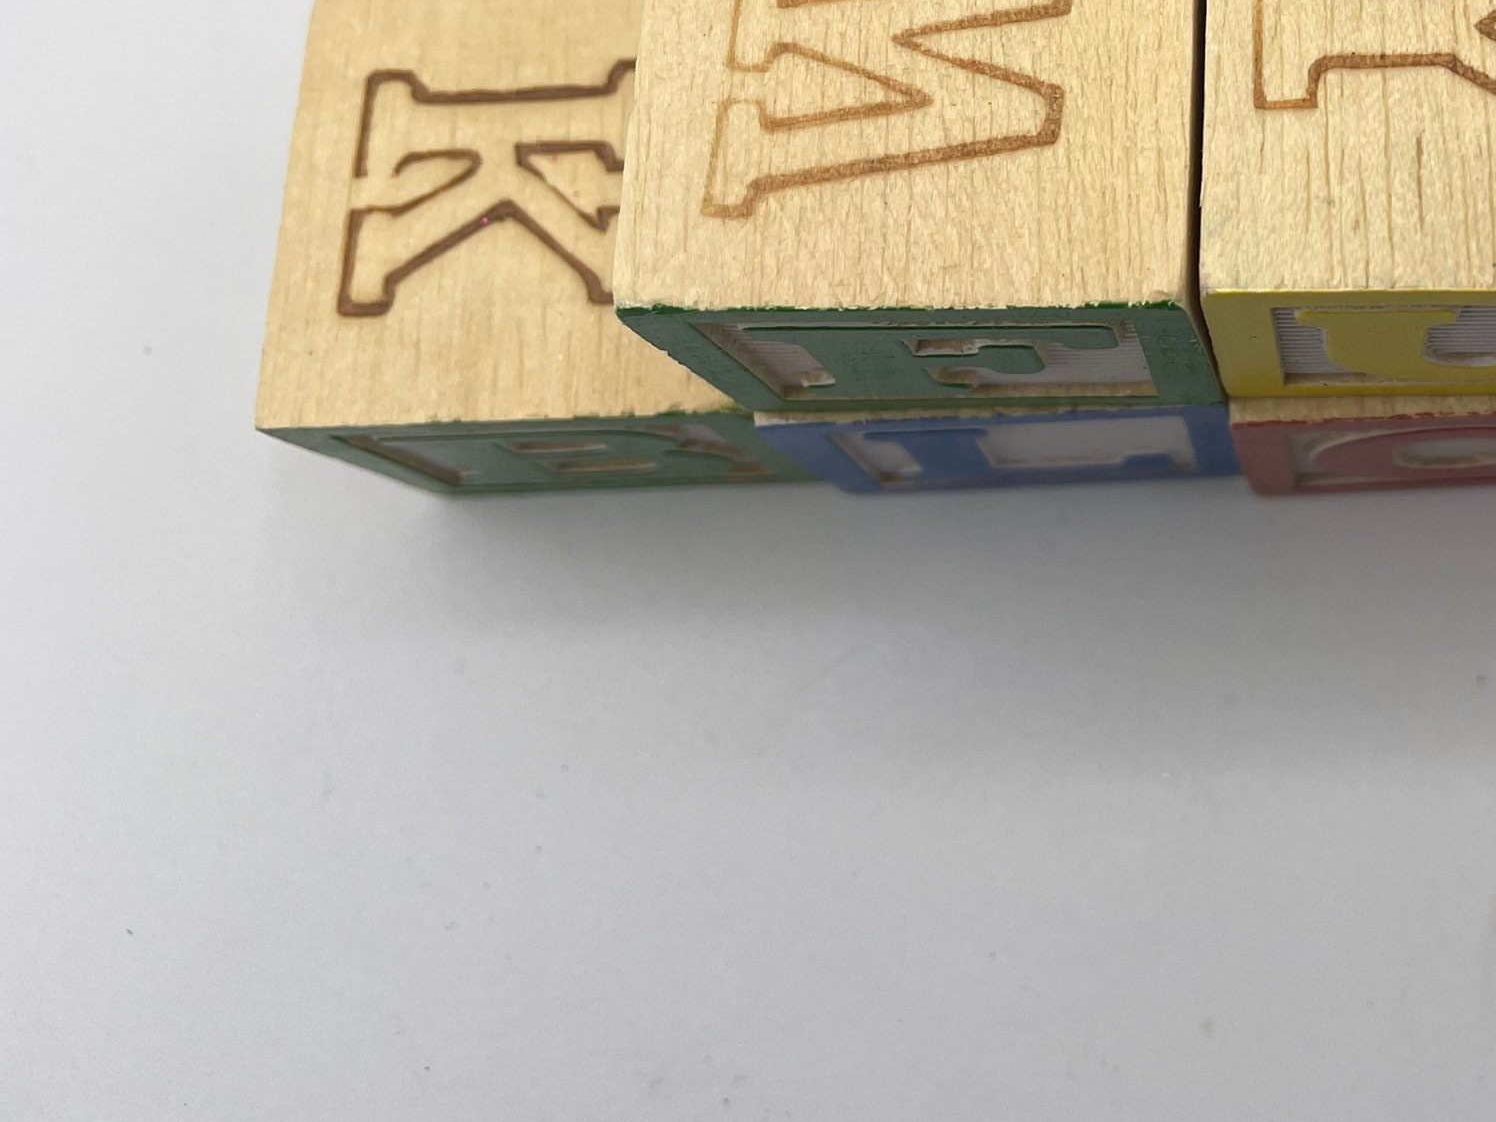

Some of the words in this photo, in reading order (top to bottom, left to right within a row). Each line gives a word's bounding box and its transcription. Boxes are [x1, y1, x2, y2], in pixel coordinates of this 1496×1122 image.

[338, 59, 637, 317] K
[743, 325, 1120, 396] F
[864, 428, 1180, 484] L
